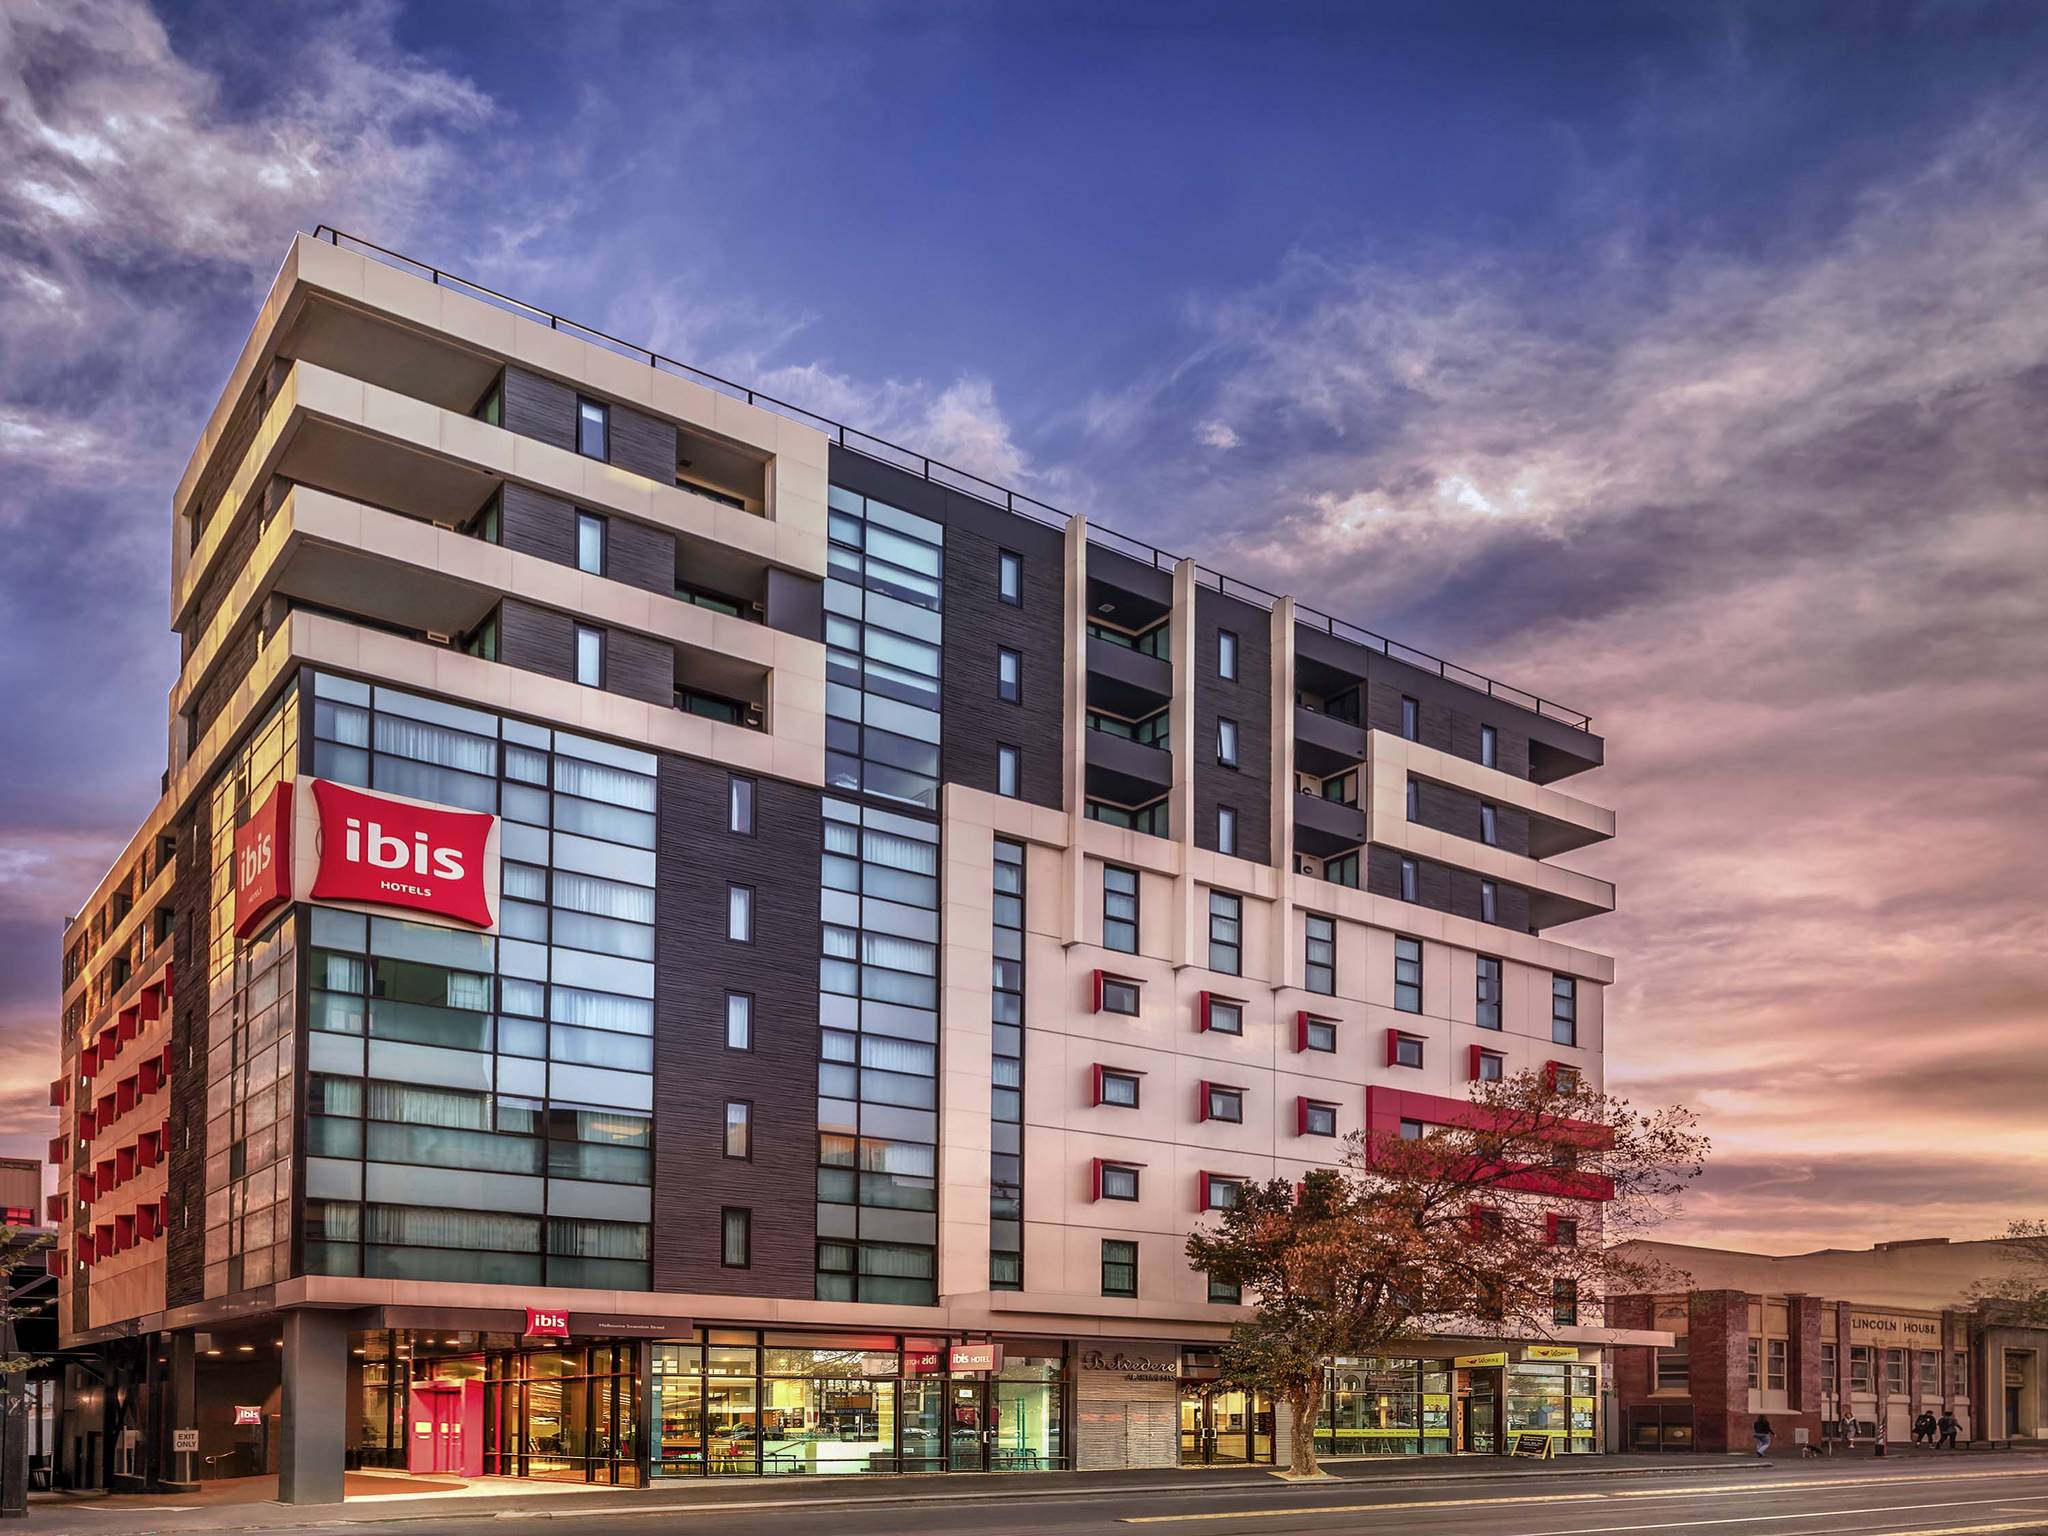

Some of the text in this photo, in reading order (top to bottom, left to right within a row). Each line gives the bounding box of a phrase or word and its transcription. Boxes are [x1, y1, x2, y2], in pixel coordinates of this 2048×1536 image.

[346, 817, 465, 880] ibis
[240, 832, 271, 892] ibis
[380, 880, 432, 897] HOTELS
[535, 1314, 565, 1327] ibis
[1852, 1319, 1936, 1335] LINCOLN HOUSE
[953, 1353, 969, 1364] ibis
[1083, 1351, 1176, 1371] Belvedere
[240, 1410, 259, 1418] ibis
[178, 1433, 195, 1441] EXIT
